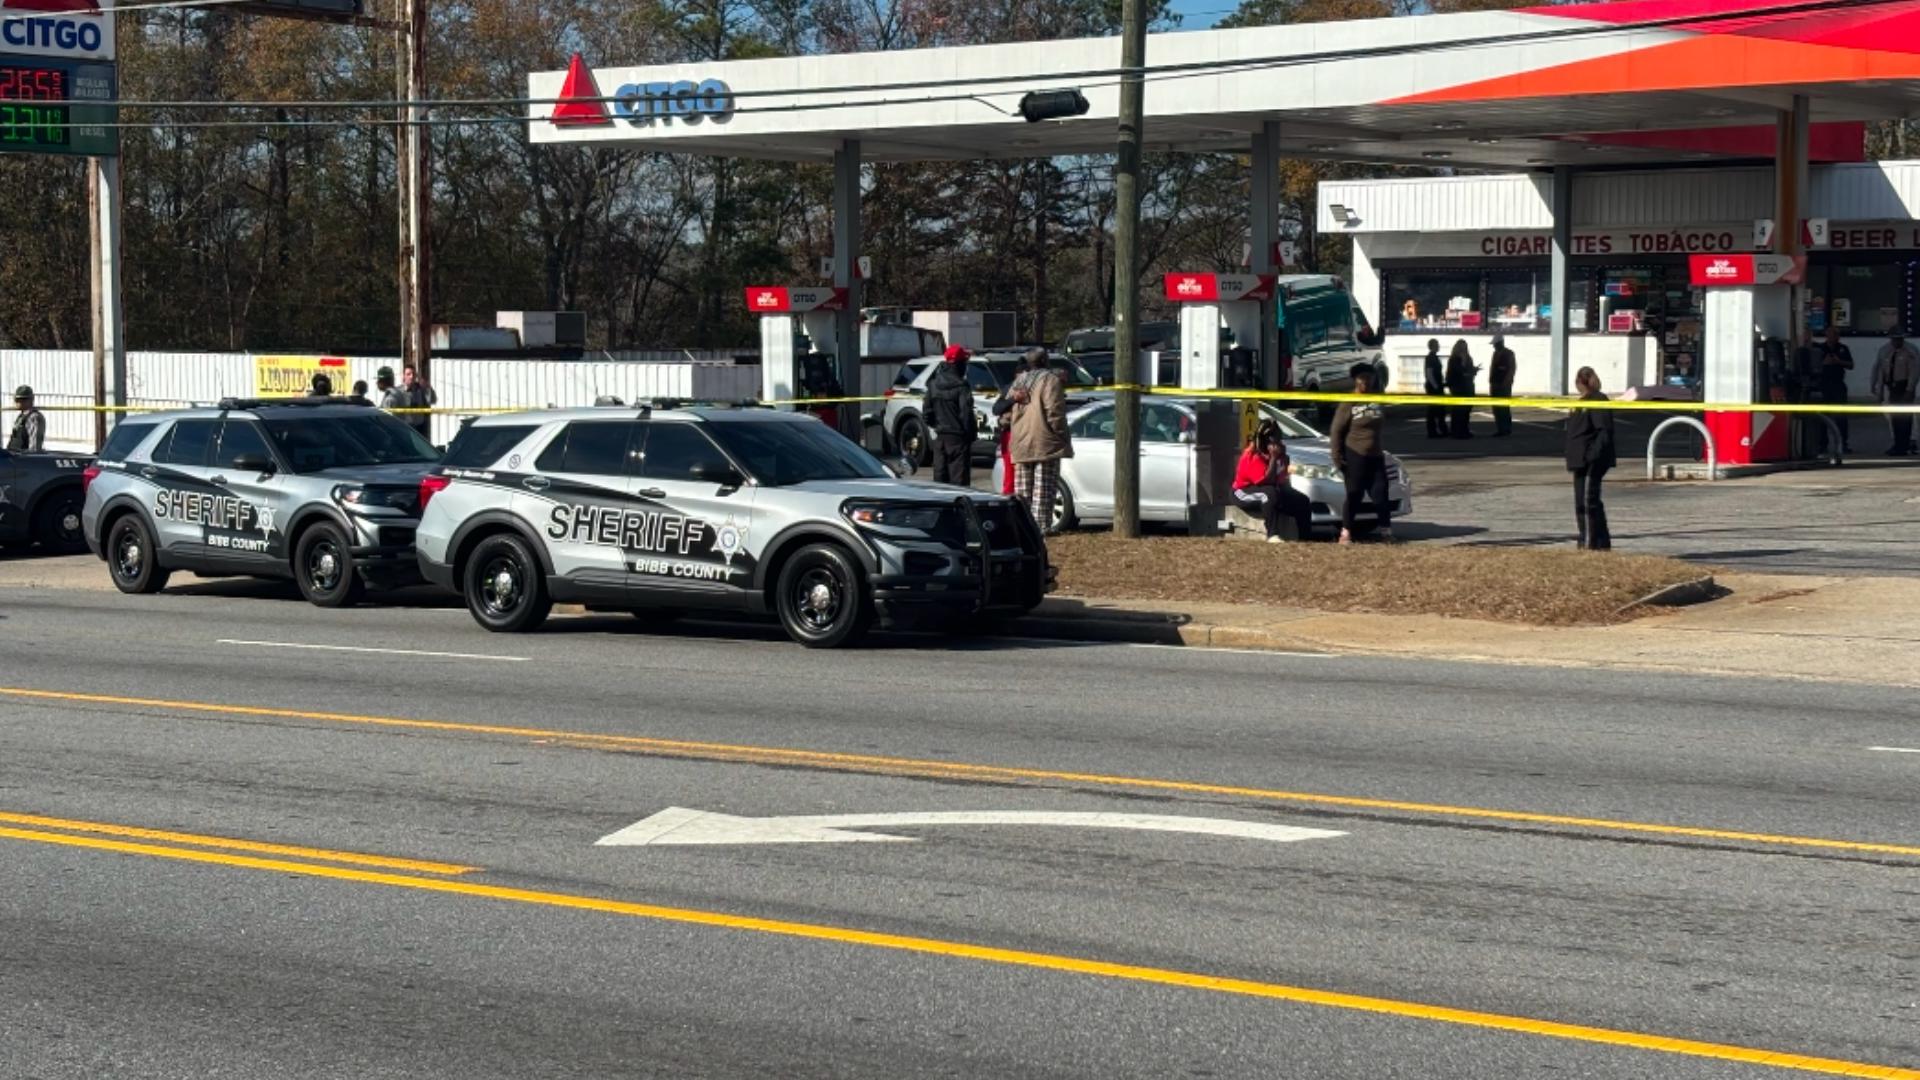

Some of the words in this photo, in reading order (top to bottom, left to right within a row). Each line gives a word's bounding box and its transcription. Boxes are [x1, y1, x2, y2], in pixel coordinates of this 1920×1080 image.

[2, 17, 102, 51] CITGO
[614, 78, 736, 127] CITGO
[1758, 226, 1767, 238] 4
[1814, 225, 1823, 237] 3
[1830, 229, 1896, 248] BEER
[1481, 234, 1612, 255] CIGARTES
[1629, 232, 1734, 252] TOBACCO
[154, 488, 252, 531] SHERIFF
[547, 502, 705, 555] SHERIFF
[231, 537, 270, 552] COUNTY
[635, 558, 669, 575] BIBB
[672, 563, 735, 581] COUNTY
